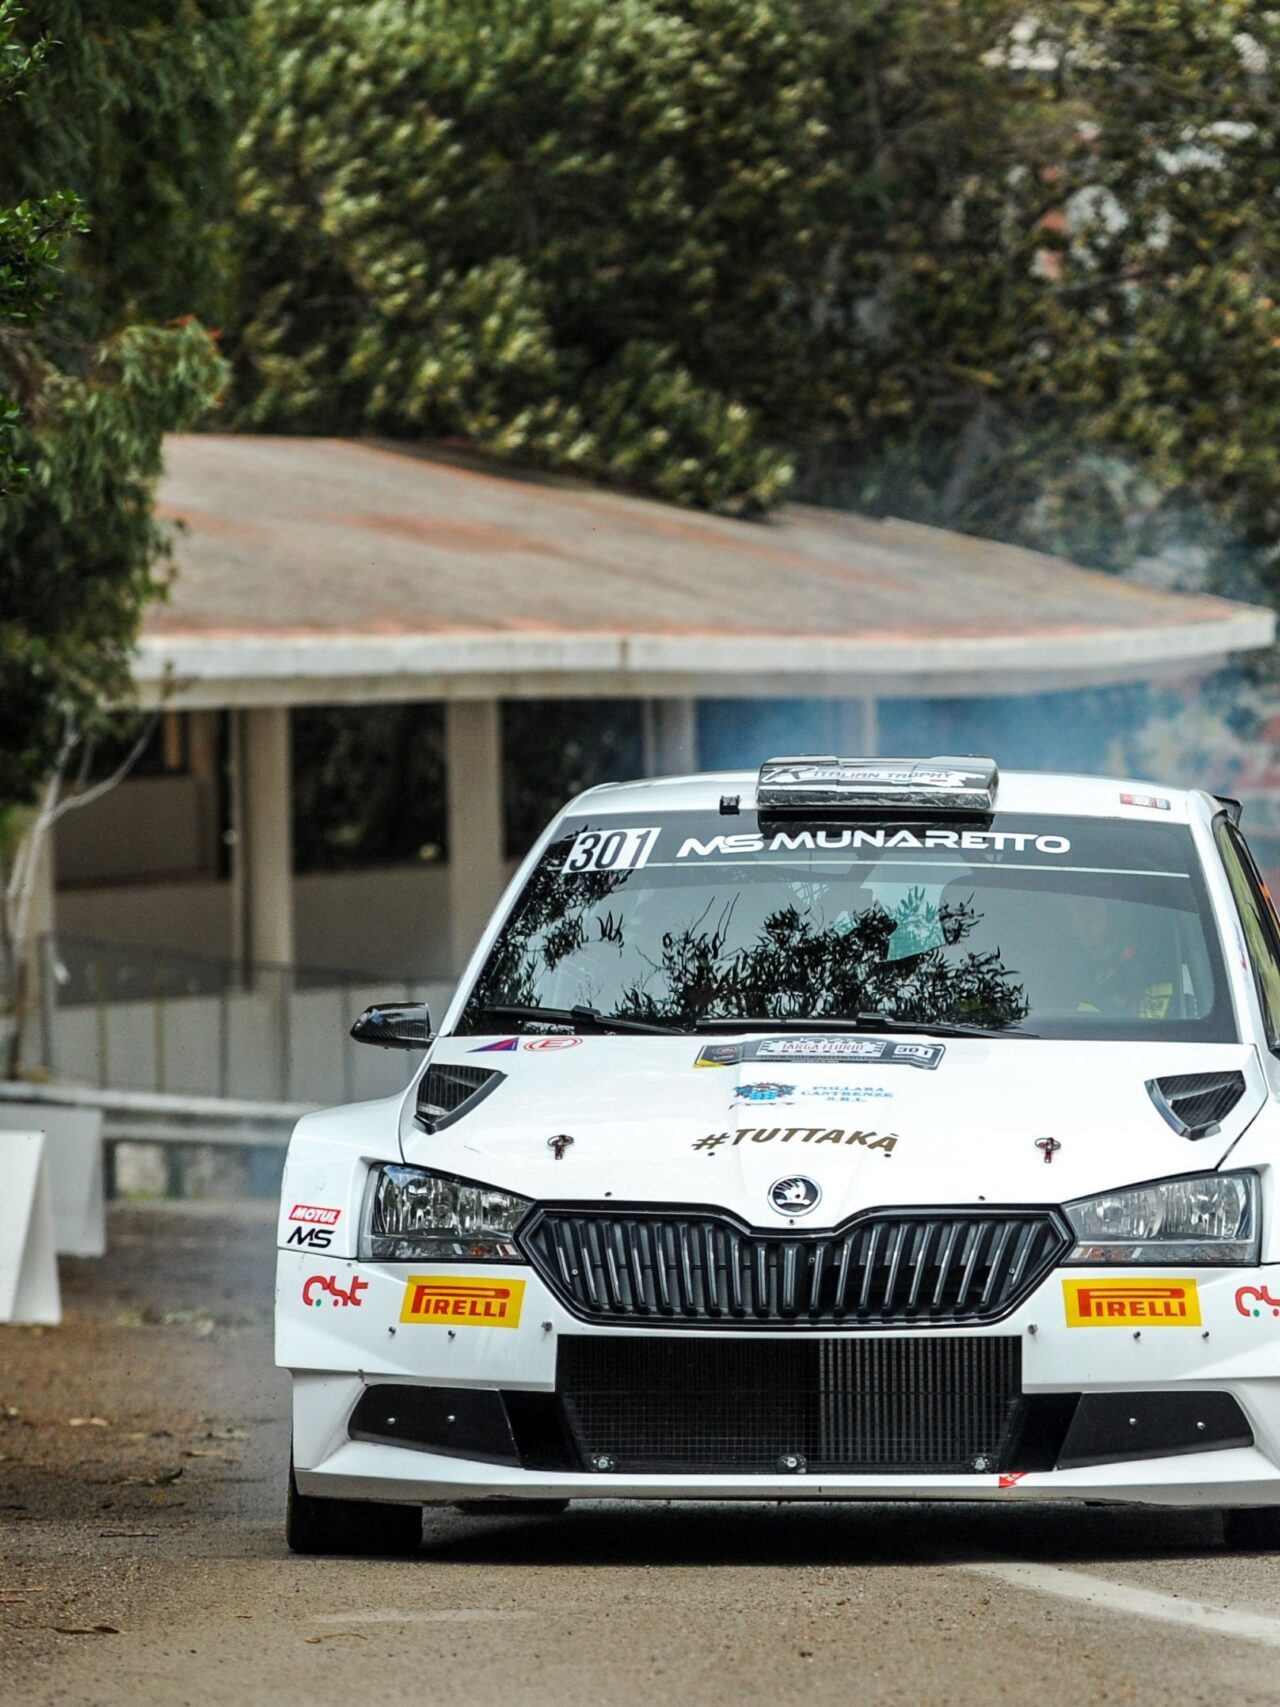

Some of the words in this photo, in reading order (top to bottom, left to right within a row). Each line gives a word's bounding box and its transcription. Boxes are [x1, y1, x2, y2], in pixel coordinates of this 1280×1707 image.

[813, 770, 881, 779] ITALIAN
[887, 770, 952, 780] TROPHY
[568, 829, 653, 871] 301
[676, 833, 764, 858] MS
[768, 830, 1071, 854] MUNARETTO
[291, 1207, 338, 1223] MOTUL
[287, 1226, 336, 1248] MS
[411, 1285, 511, 1317] PIRELLI
[1077, 1288, 1186, 1317] PIRELLI
